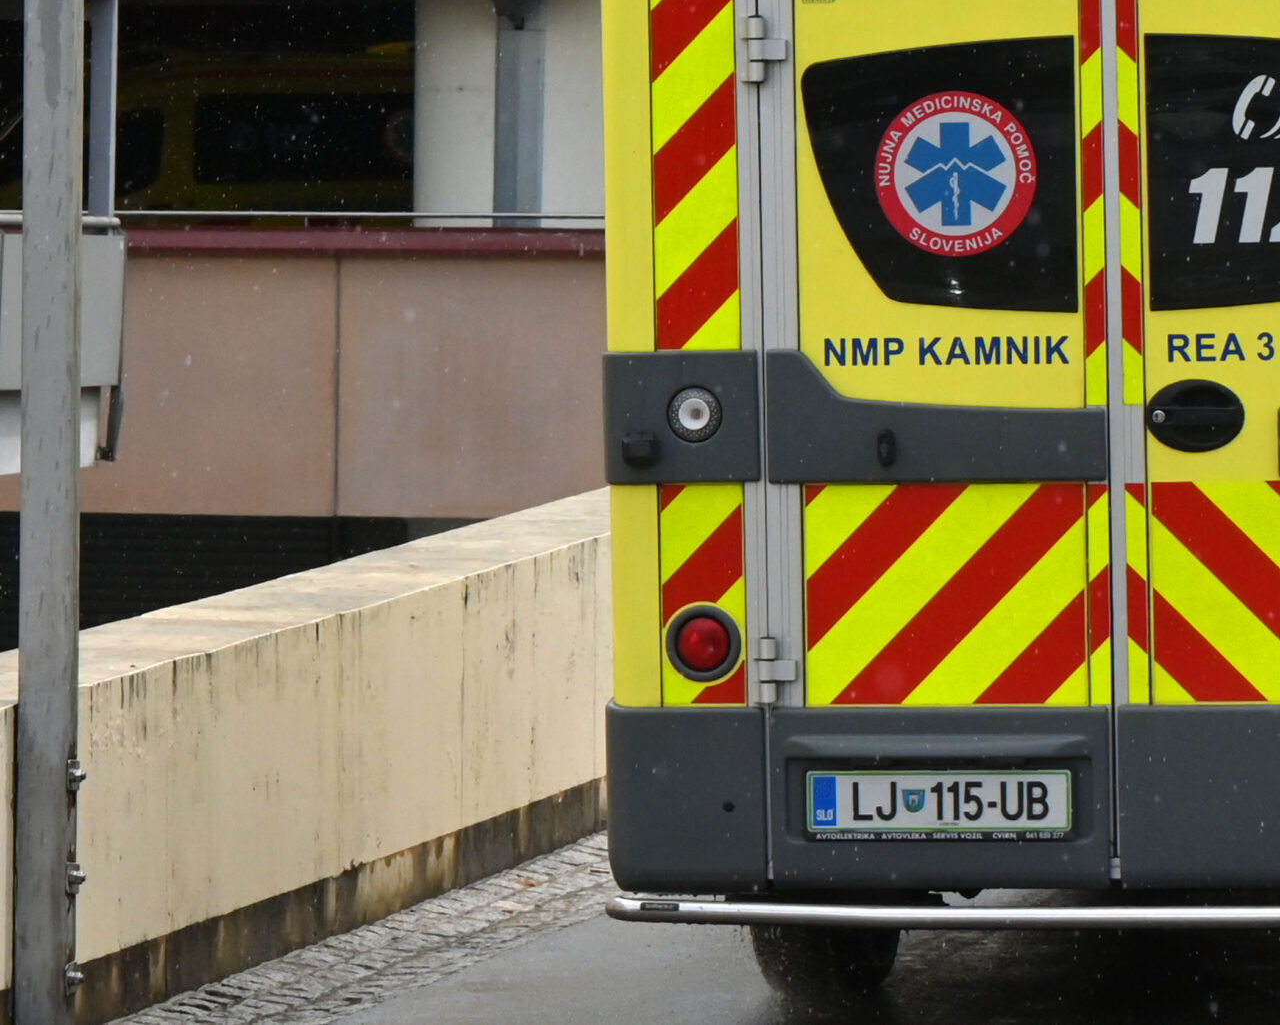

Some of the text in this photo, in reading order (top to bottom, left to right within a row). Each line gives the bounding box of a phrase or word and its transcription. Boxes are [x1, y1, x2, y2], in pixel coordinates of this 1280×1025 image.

[879, 96, 1036, 187] NUJNA MEDICINSKA POMOČ
[909, 227, 1003, 252] SLOVENIJA
[823, 335, 1070, 367] NMP KAMNIK
[1167, 331, 1275, 363] REA 3
[816, 809, 834, 821] SLO
[852, 781, 1050, 821] LJ 115-UB
[932, 832, 958, 840] SERVIS
[960, 832, 983, 840] VOZIL
